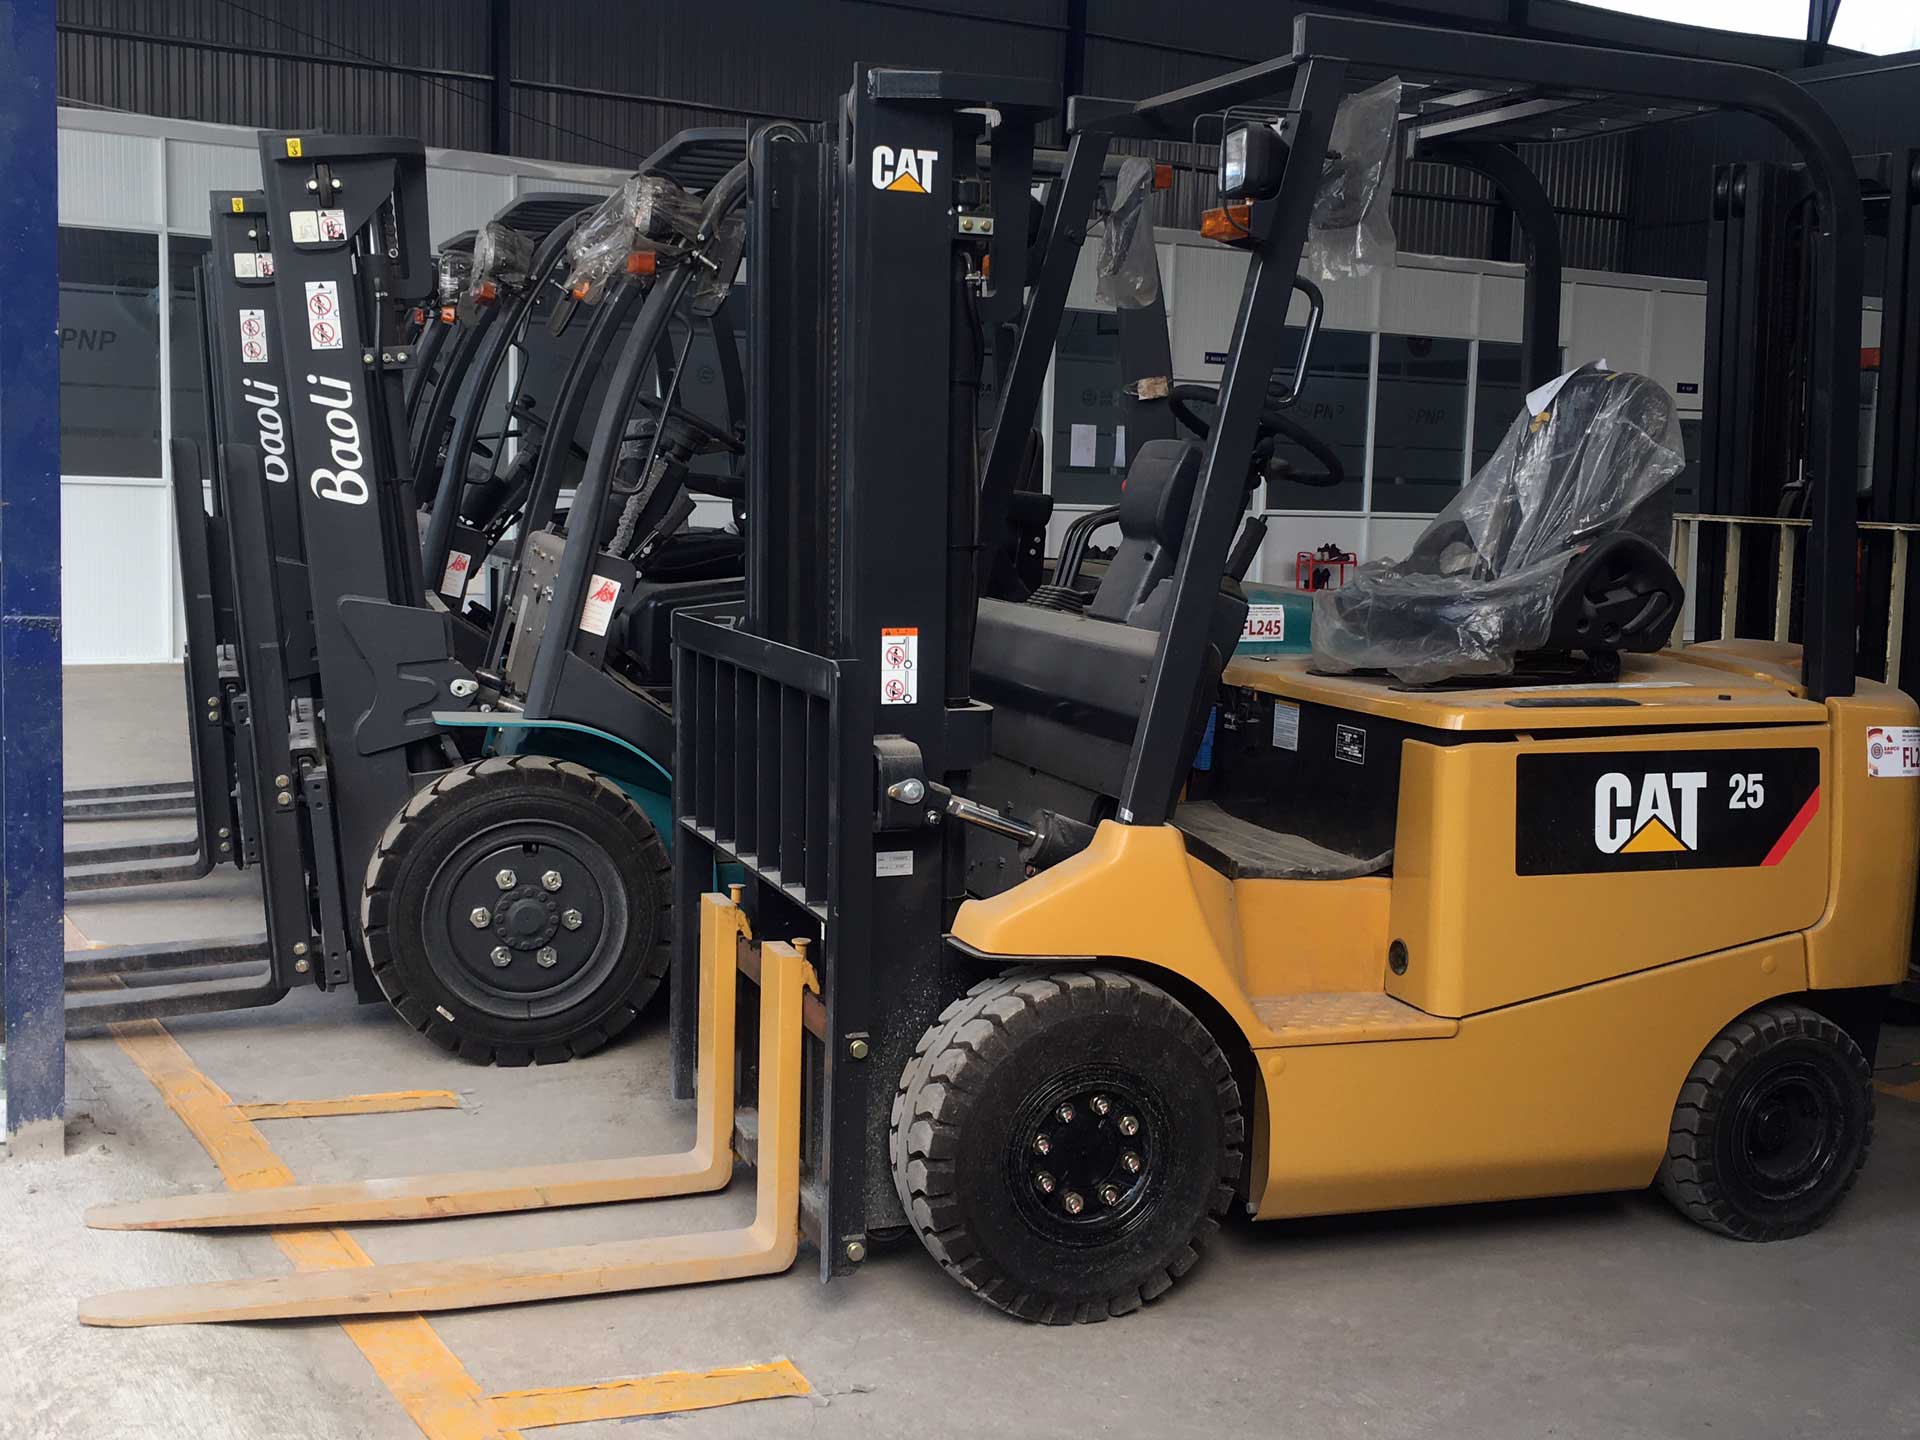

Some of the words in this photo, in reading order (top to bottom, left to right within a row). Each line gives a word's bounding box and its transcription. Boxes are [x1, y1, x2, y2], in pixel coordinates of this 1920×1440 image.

[872, 145, 938, 193] CAT
[60, 327, 119, 352] PNP
[306, 374, 369, 505] Baoli
[1594, 772, 1707, 854] CAT
[1729, 773, 1766, 810] 25
